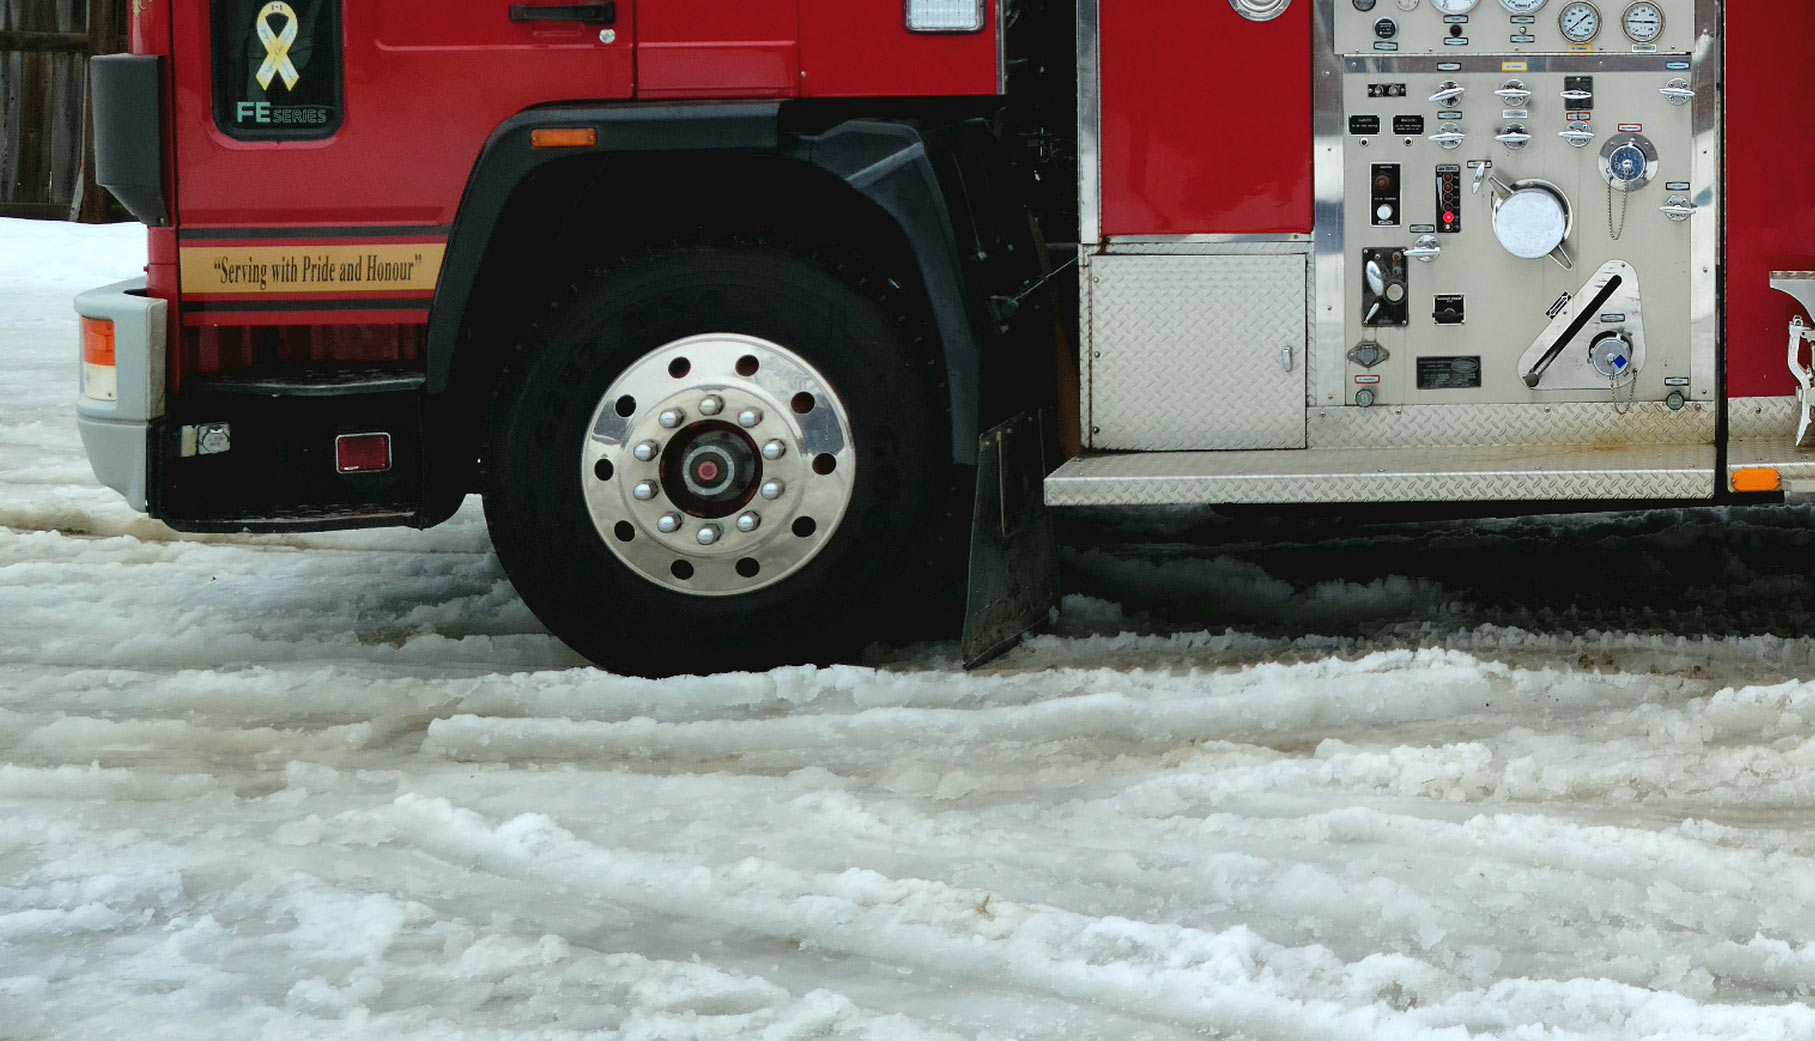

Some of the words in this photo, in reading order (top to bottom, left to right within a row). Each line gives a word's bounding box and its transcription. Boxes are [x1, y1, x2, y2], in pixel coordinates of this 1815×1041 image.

[236, 101, 271, 123] FE
[272, 109, 328, 124] SERIES
[271, 256, 298, 283] with
[302, 255, 335, 283] Pride
[339, 255, 363, 283] and
